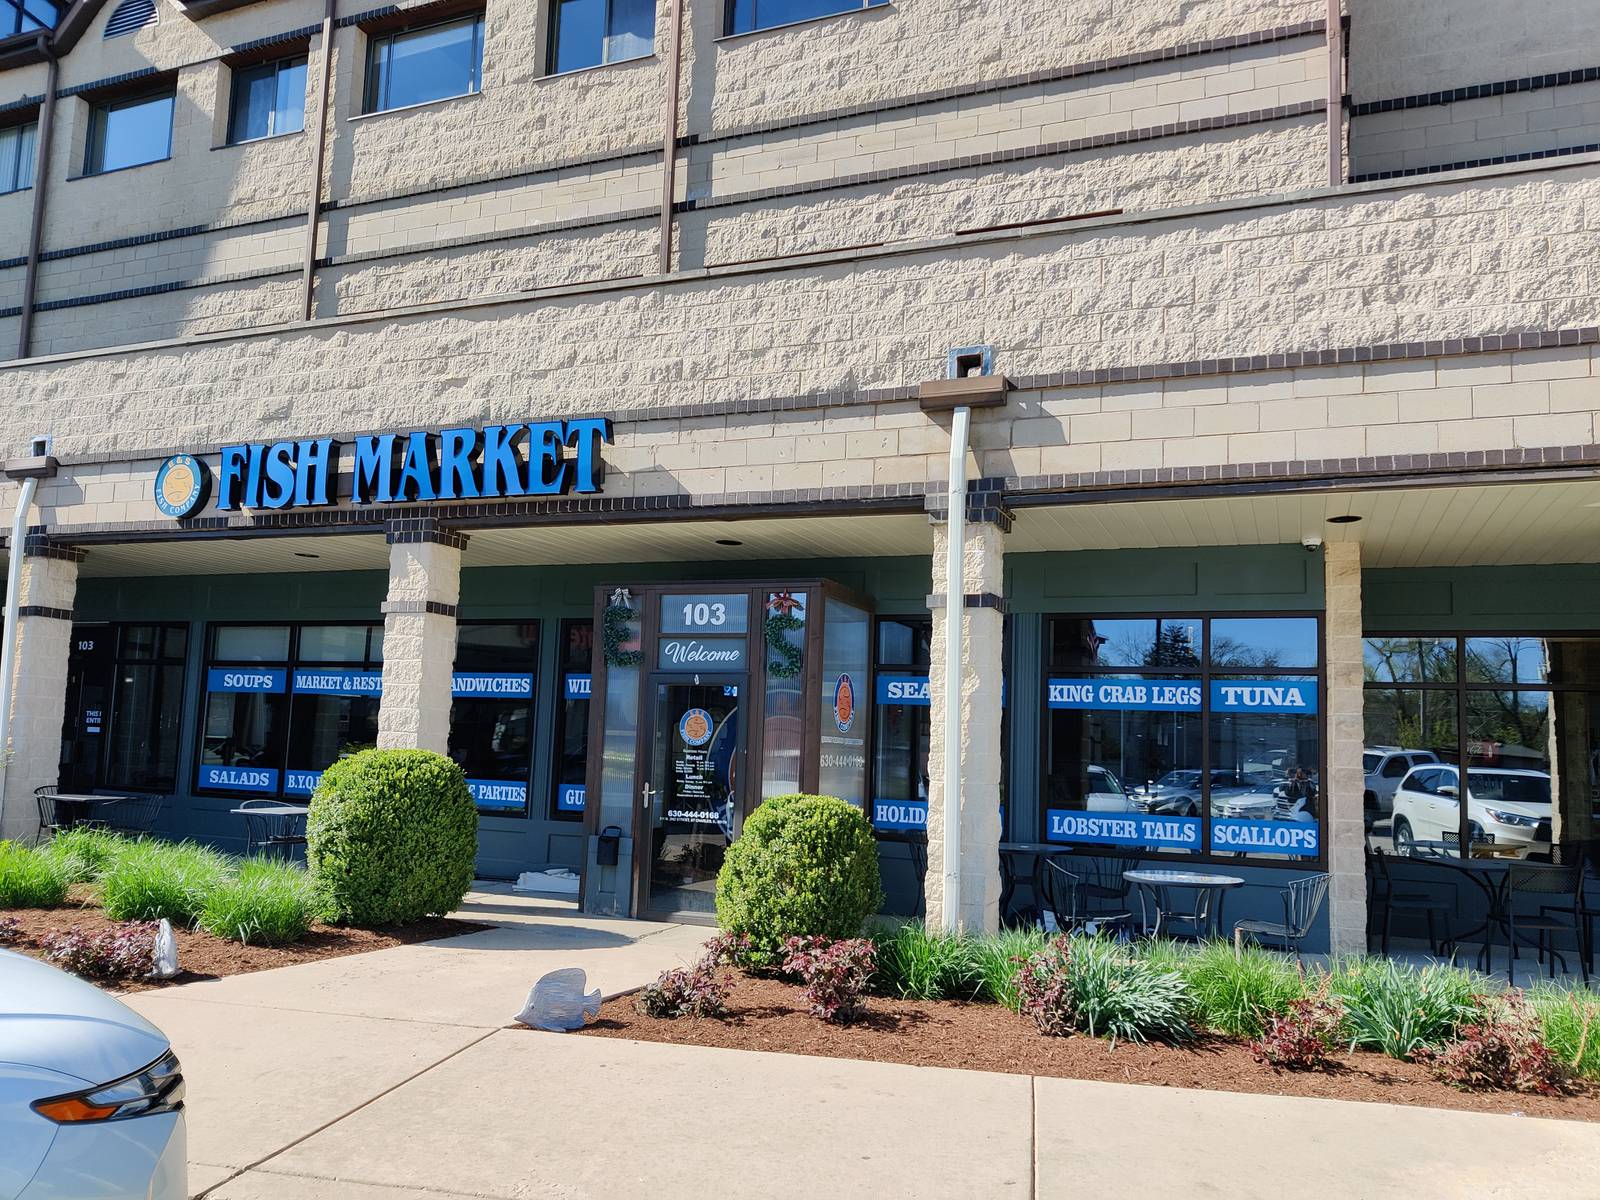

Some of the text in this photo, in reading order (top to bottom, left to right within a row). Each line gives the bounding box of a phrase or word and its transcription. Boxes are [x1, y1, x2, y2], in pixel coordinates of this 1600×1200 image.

[215, 417, 614, 511] FISH MARKET
[683, 603, 726, 626] 103
[78, 640, 95, 651] 103
[664, 640, 741, 664] Welcome
[223, 673, 273, 689] SOUPS
[296, 675, 343, 690] MARKET
[343, 676, 351, 691] &
[1048, 684, 1202, 706] KING CRAB LEGS
[1221, 686, 1306, 707] TUNA
[209, 770, 270, 787] SALADS
[479, 785, 527, 802] PARTIES
[667, 809, 719, 819] 630-444-0168
[876, 804, 928, 824] HOLID
[1052, 816, 1196, 842] LOBSTER TAILS
[1214, 825, 1317, 849] SCALLOPS
